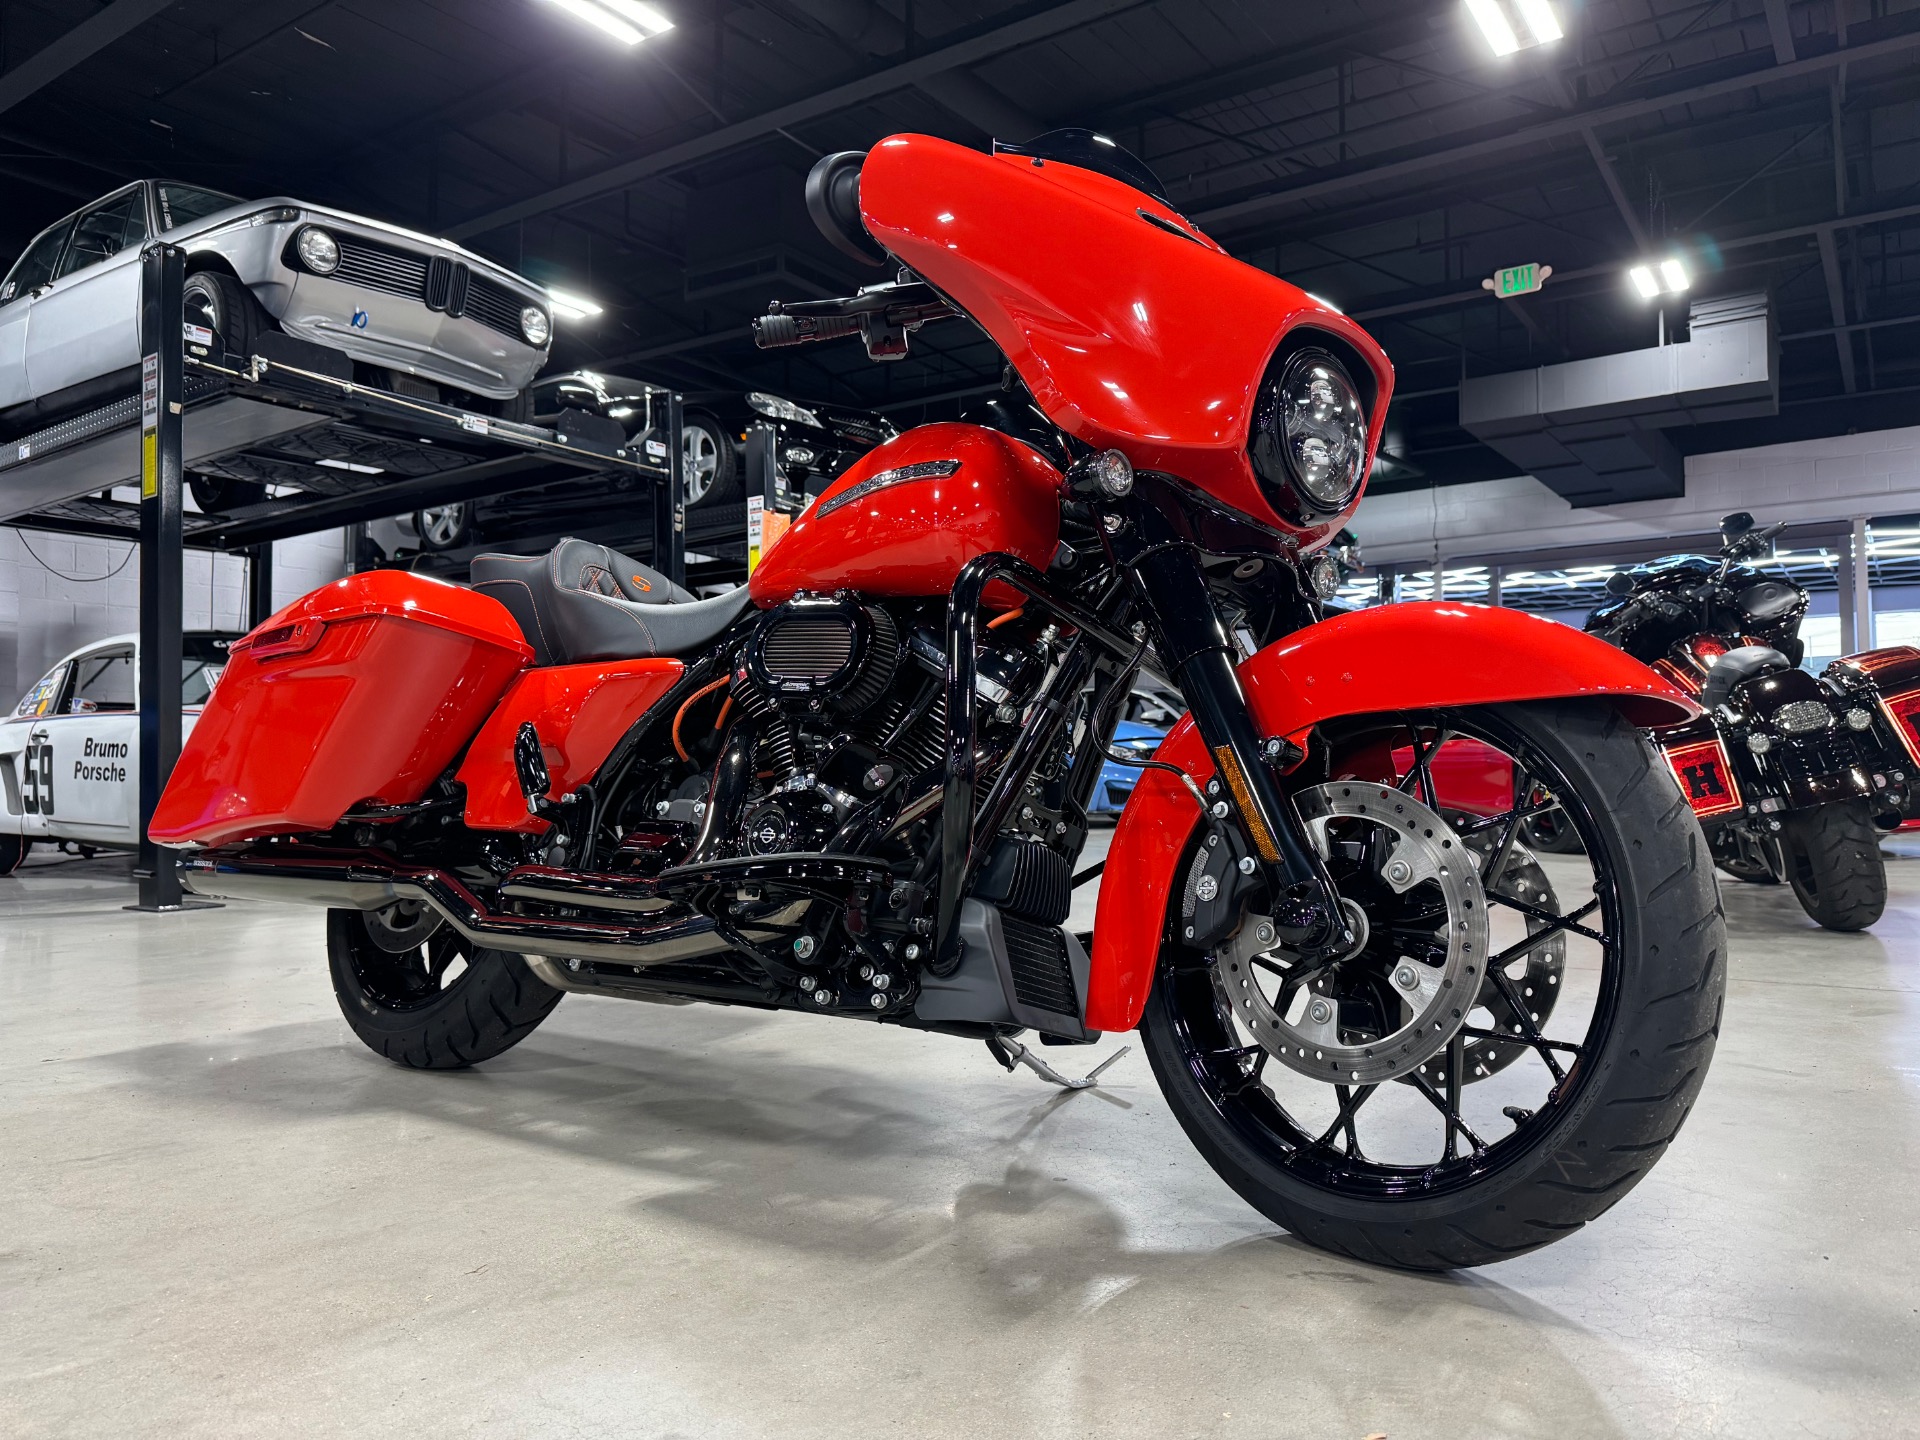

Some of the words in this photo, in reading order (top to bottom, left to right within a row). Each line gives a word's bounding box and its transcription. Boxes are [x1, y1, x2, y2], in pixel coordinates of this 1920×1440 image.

[1502, 265, 1534, 294] EXIT
[84, 737, 128, 758] Brumo
[24, 745, 54, 815] 59
[74, 761, 126, 782] Porsche
[1682, 762, 1724, 798] H
